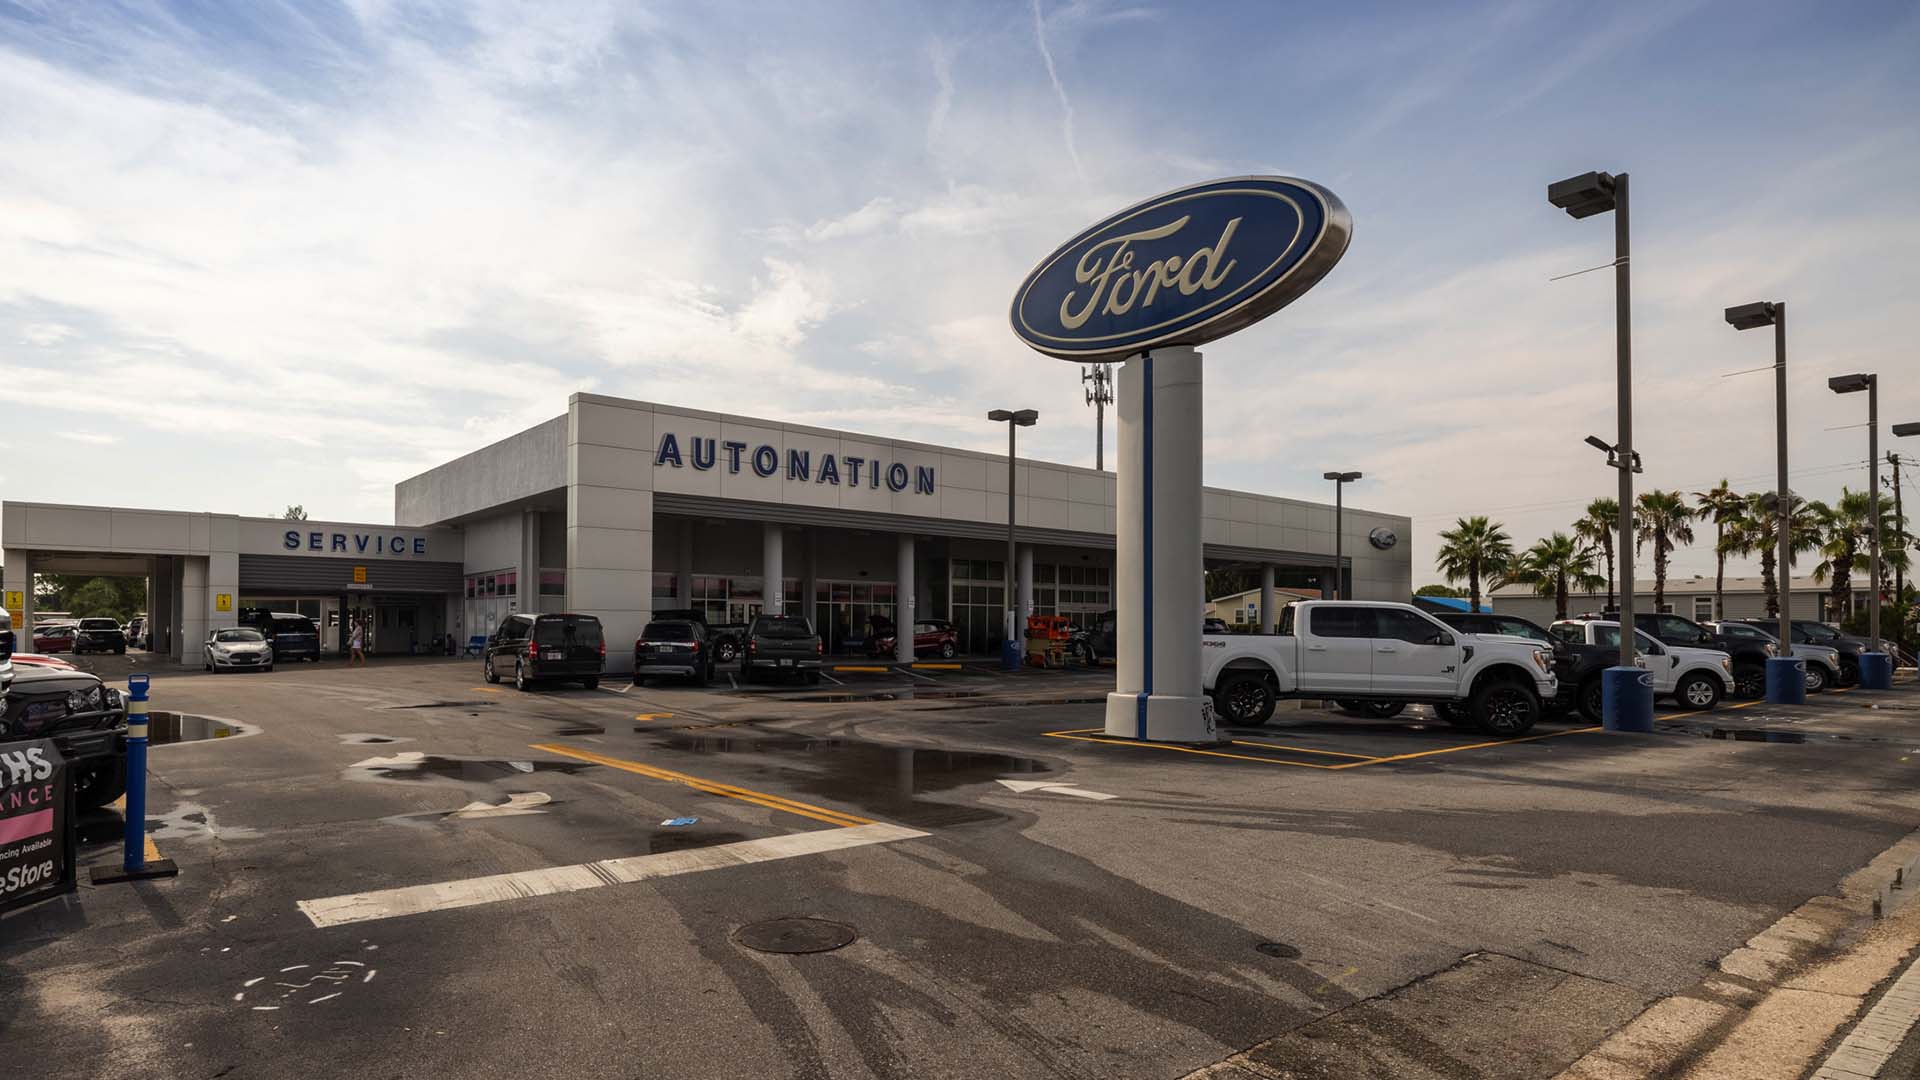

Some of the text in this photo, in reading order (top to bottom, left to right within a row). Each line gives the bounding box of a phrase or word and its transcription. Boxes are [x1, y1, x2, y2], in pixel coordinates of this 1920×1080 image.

[1060, 214, 1243, 330] Ford
[654, 432, 936, 495] AUTONATION
[284, 529, 427, 555] SERVICE
[22, 838, 53, 855] Available
